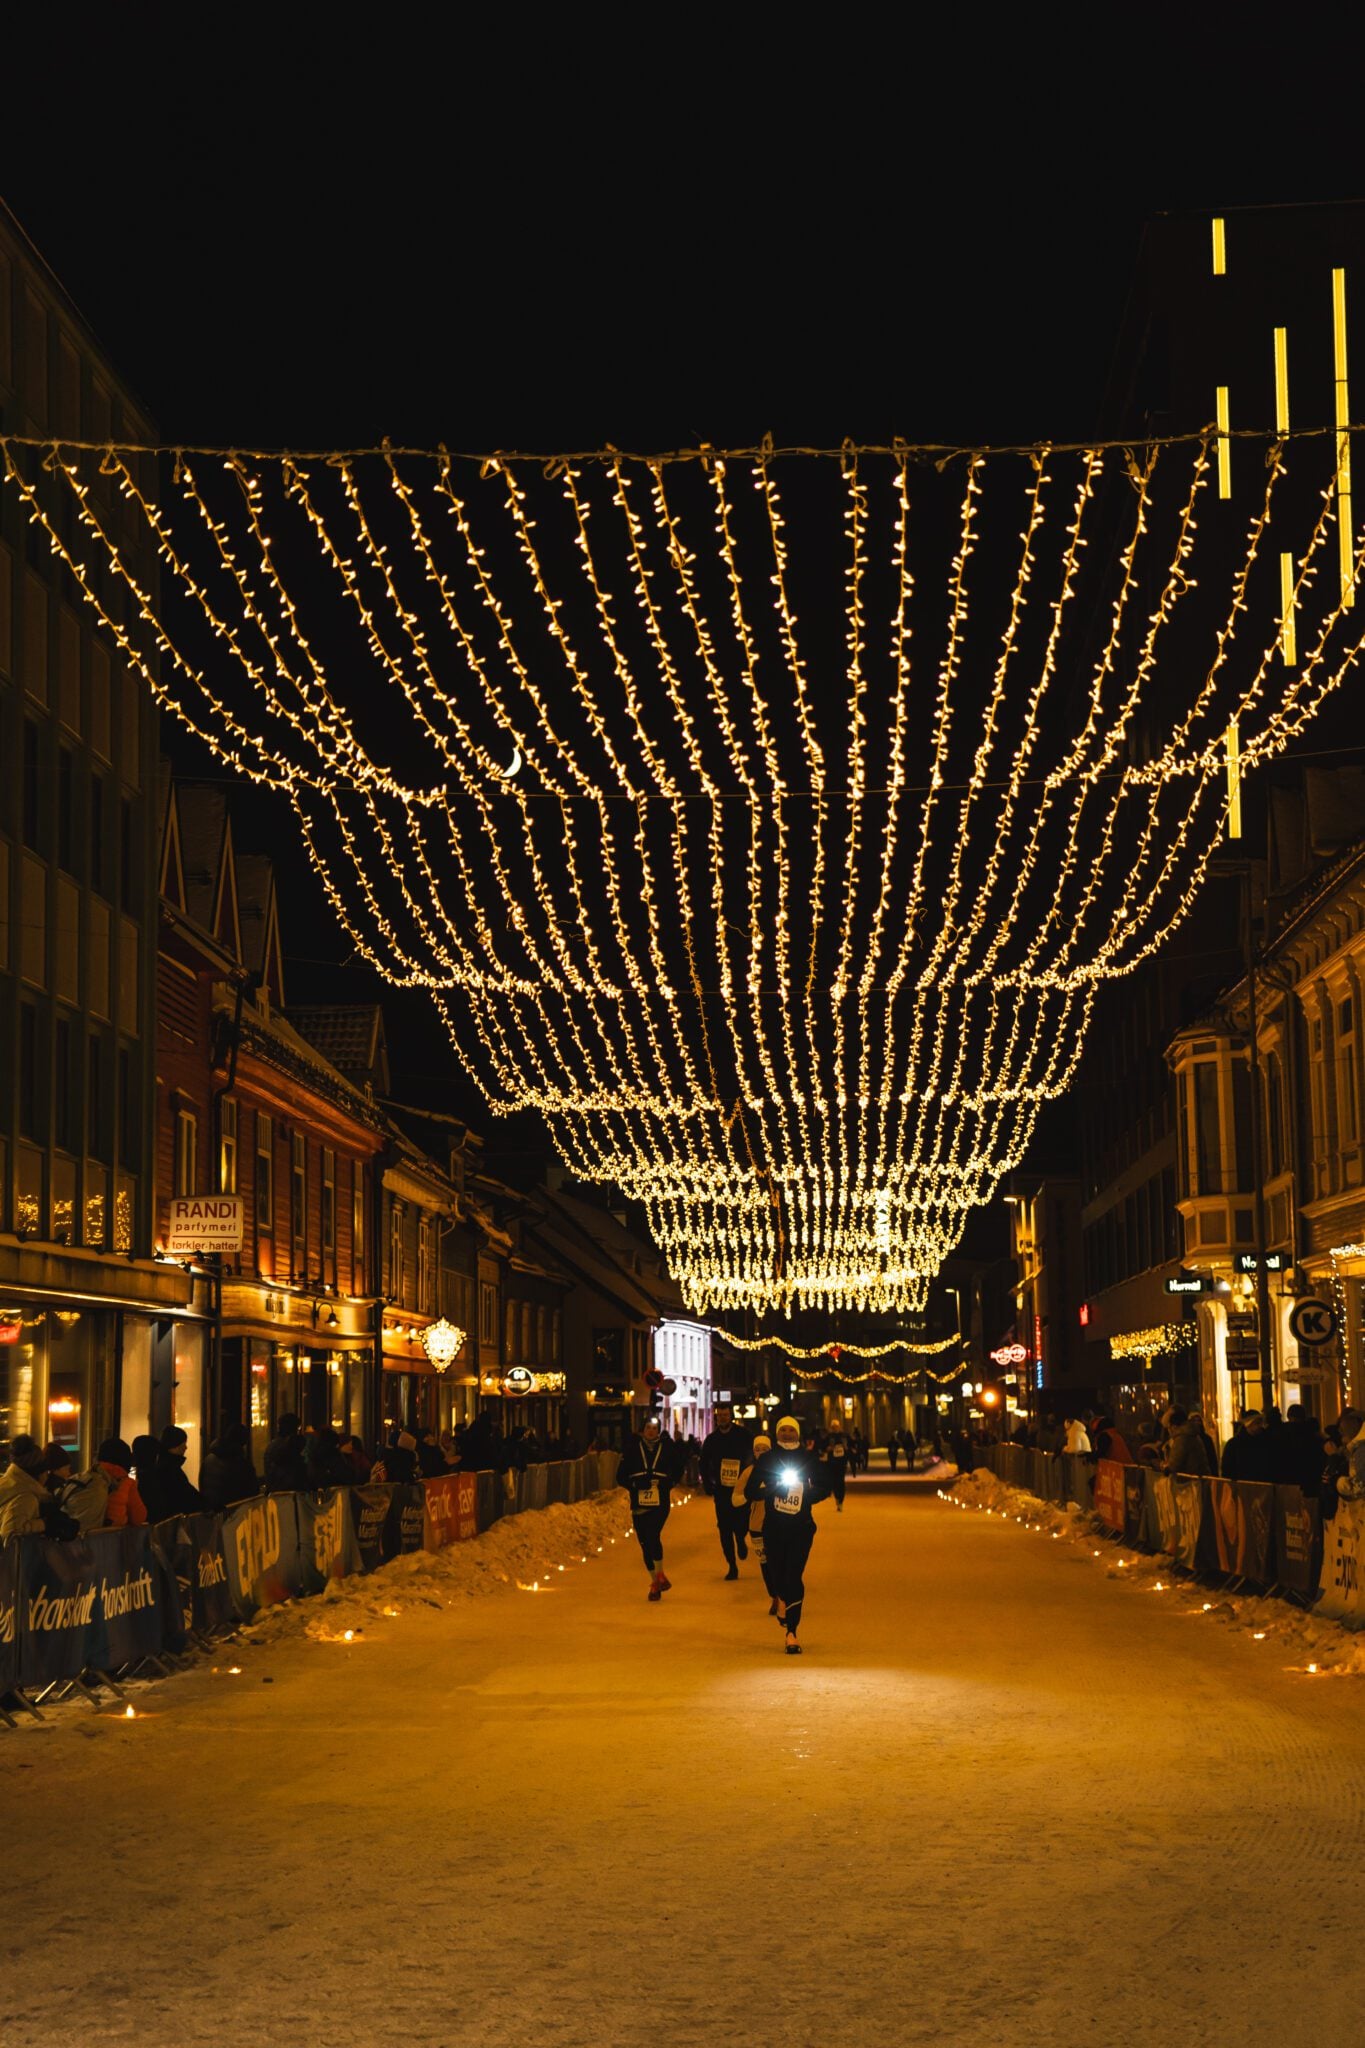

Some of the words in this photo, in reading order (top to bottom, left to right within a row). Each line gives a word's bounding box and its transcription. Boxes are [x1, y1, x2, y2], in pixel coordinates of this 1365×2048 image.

[176, 1202, 236, 1218] RANDI
[175, 1222, 236, 1232] parfymeri
[1242, 1256, 1280, 1269] Noal
[1169, 1280, 1201, 1292] Normal
[1302, 1311, 1327, 1334] K
